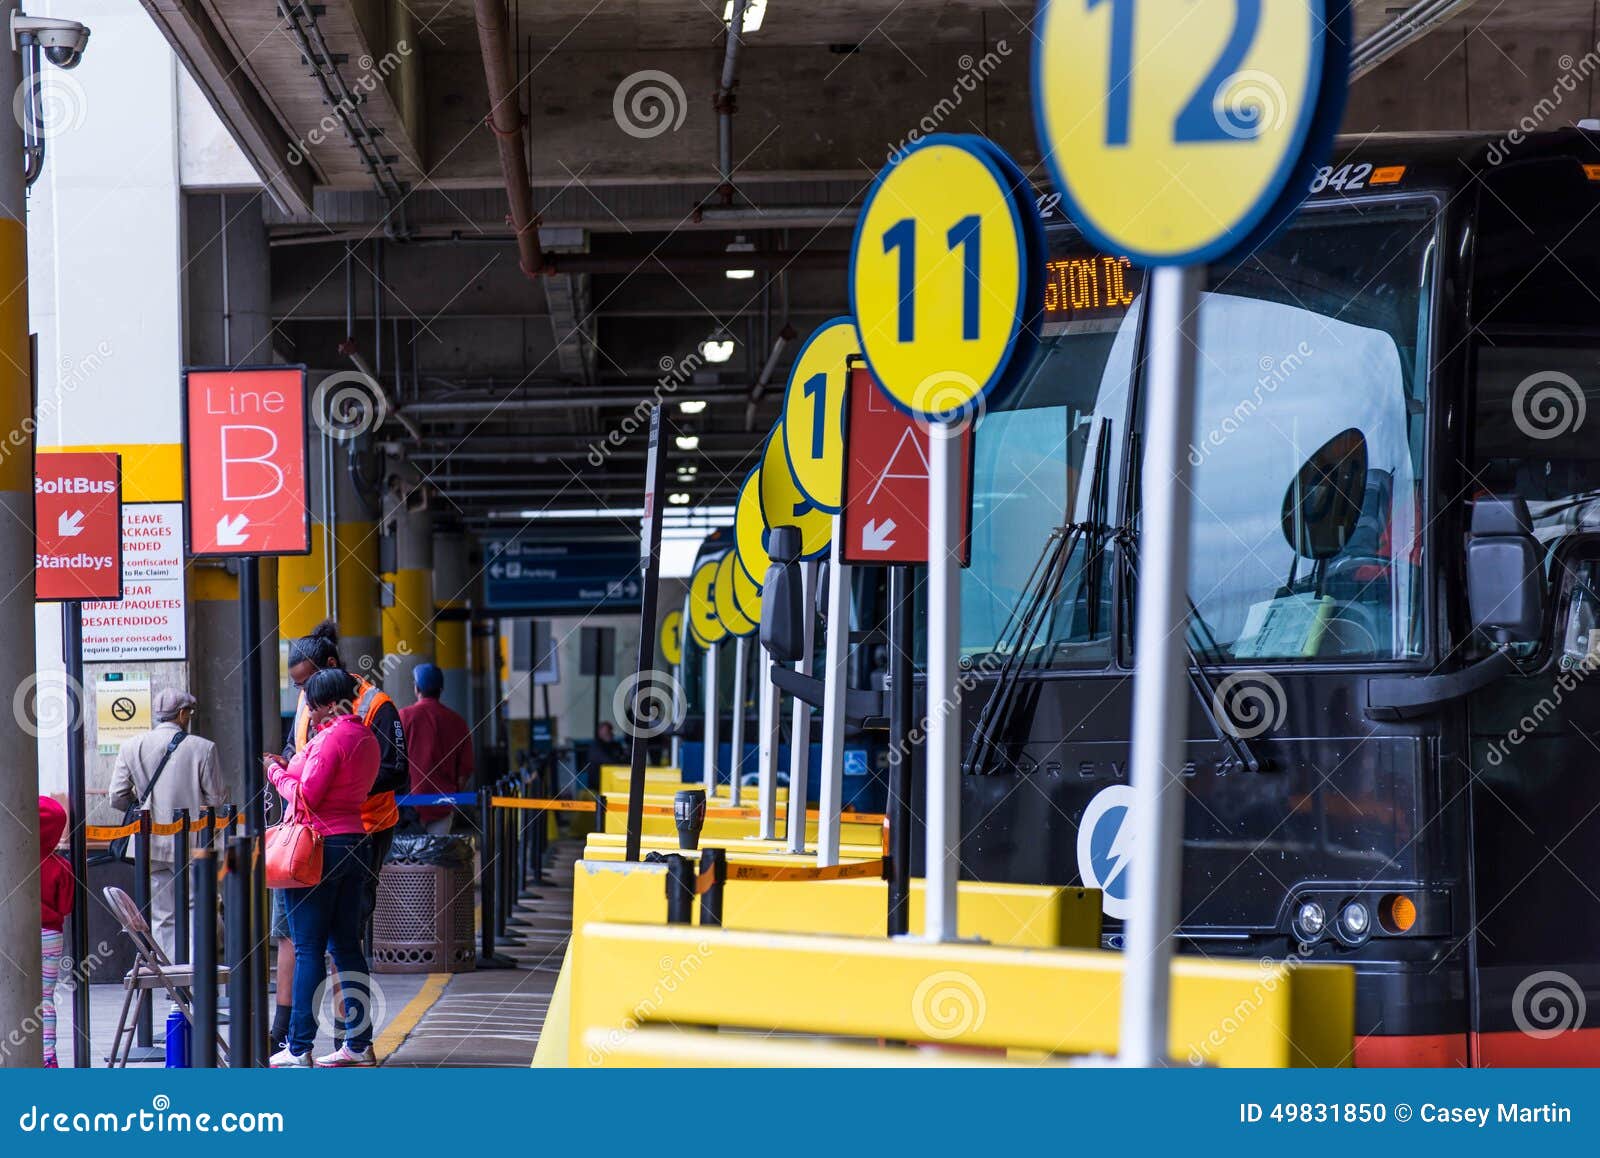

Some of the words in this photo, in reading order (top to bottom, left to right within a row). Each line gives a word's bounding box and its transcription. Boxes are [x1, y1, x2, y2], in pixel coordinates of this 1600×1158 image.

[1084, 0, 1264, 147] 12
[1308, 163, 1373, 193] 842
[882, 214, 981, 344] 11
[1103, 256, 1133, 305] DC
[206, 386, 285, 415] Line
[221, 425, 284, 501] B
[867, 426, 930, 505] A
[128, 515, 163, 525] LEAVE
[127, 558, 178, 567] confiscated
[124, 586, 152, 596] EJAR
[81, 616, 168, 627] DESATENDIDOS
[84, 646, 110, 655] require
[139, 645, 177, 654] recogerlos
[126, 633, 173, 643] conscados
[393, 720, 405, 750] BOLT
